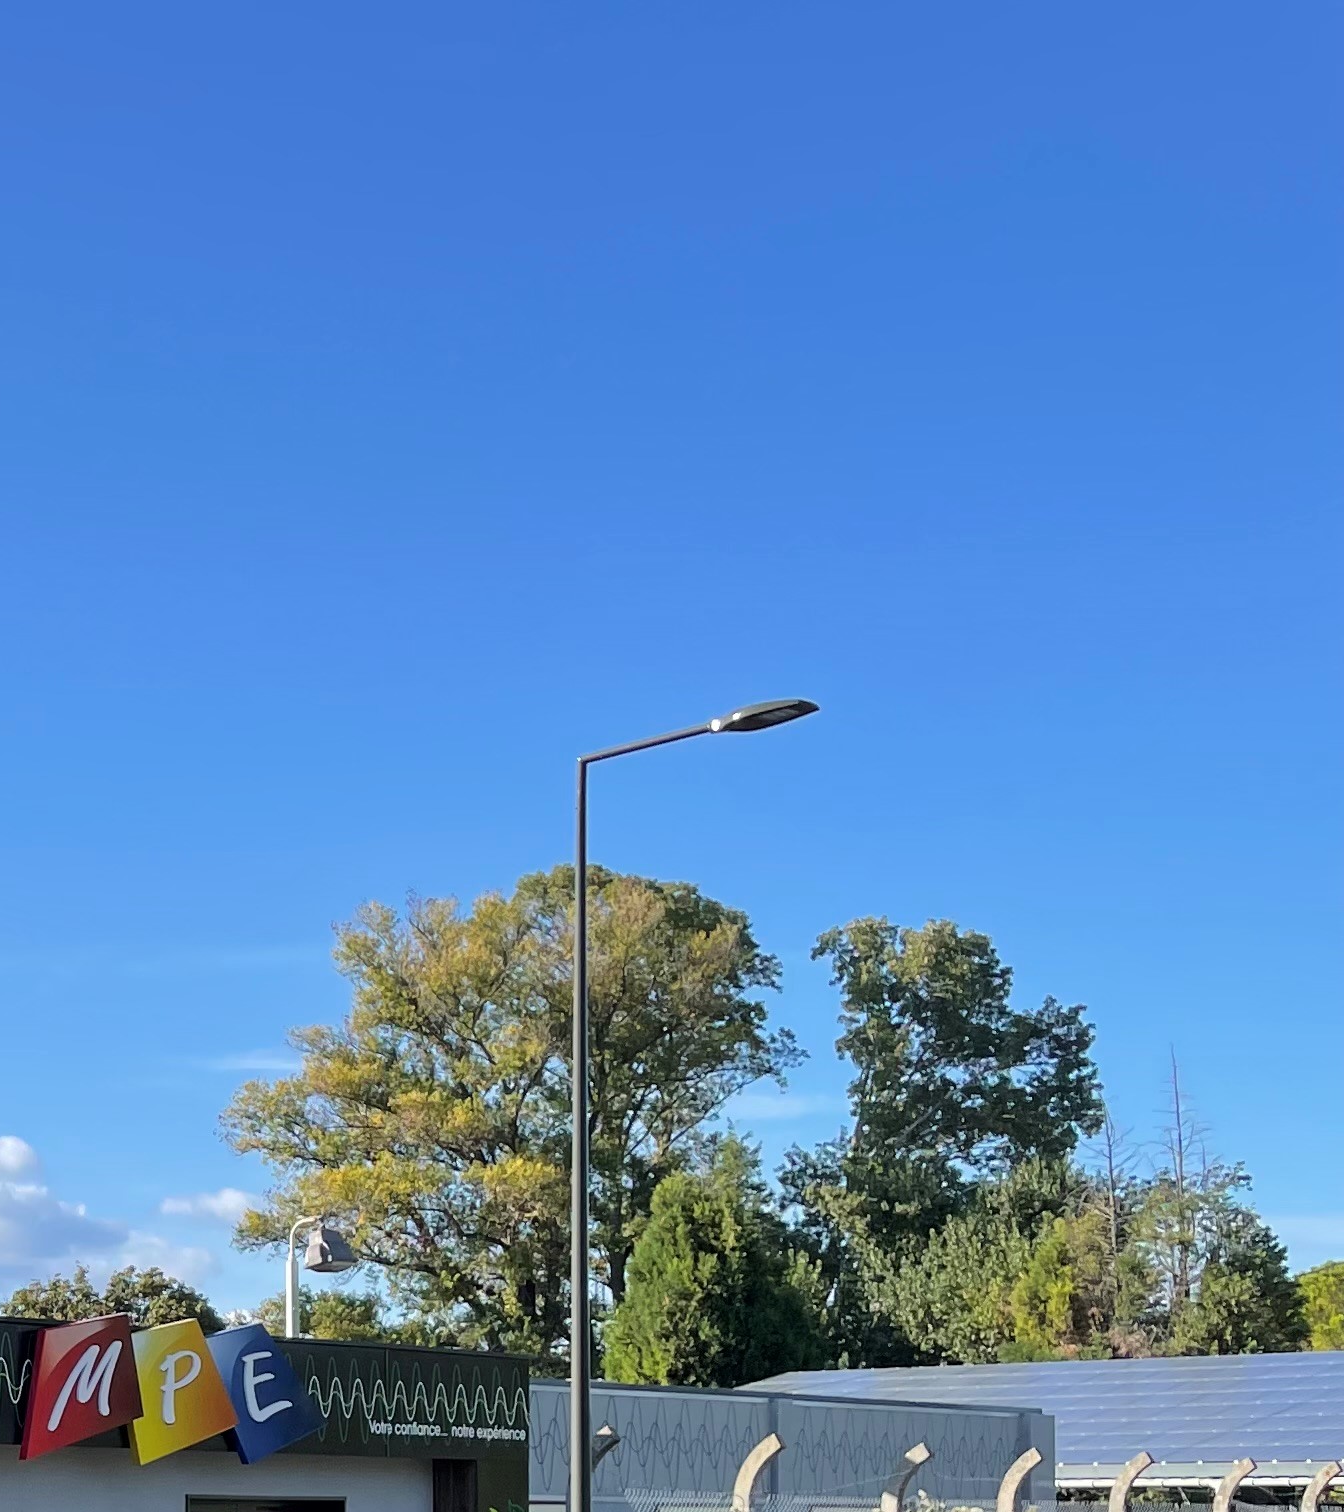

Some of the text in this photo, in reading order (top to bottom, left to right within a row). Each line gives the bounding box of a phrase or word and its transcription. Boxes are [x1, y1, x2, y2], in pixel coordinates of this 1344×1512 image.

[47, 1340, 292, 1431] MPE
[368, 1420, 393, 1434] Votre
[451, 1424, 474, 1438] notre
[476, 1425, 526, 1441] expérience
